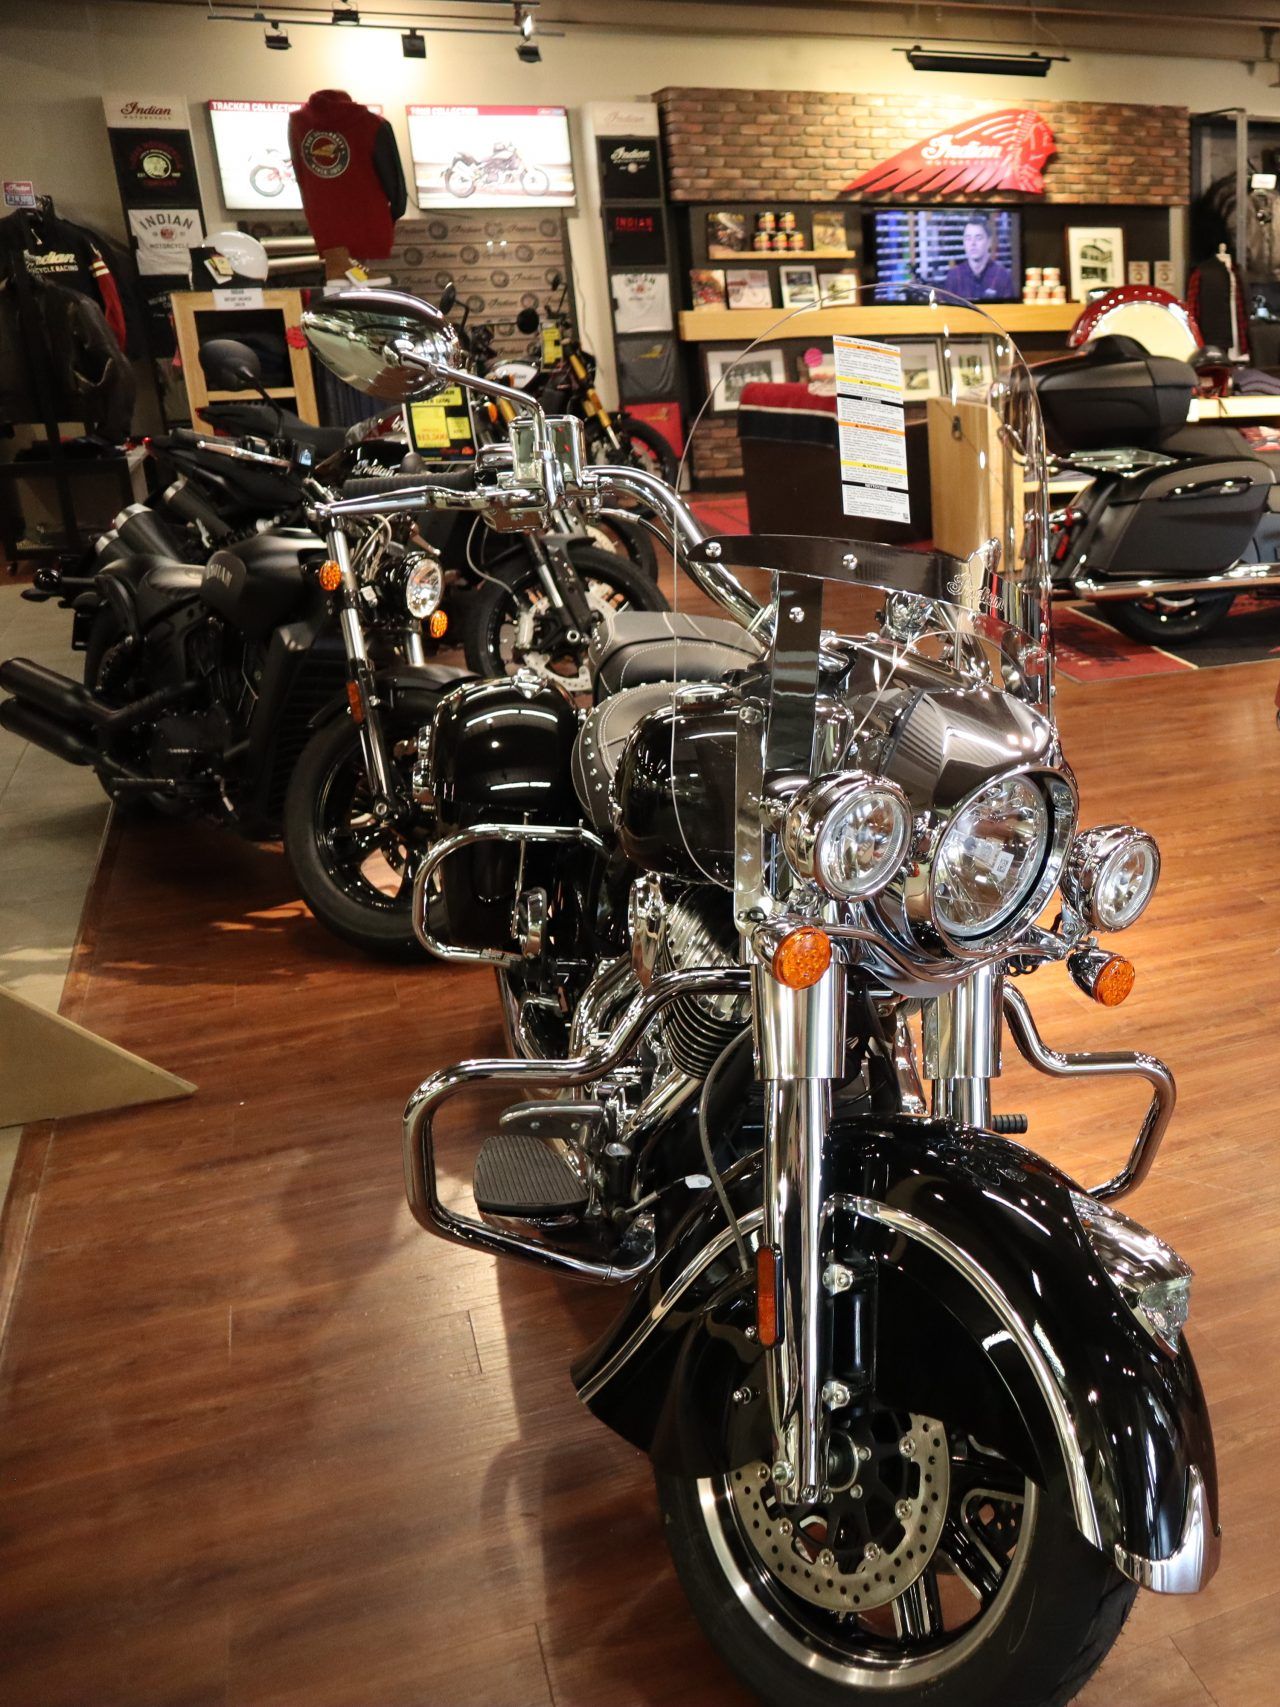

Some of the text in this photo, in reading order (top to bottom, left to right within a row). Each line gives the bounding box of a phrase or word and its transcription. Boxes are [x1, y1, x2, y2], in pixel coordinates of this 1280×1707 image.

[120, 102, 172, 116] Indian
[211, 101, 250, 111] TRACKER
[610, 146, 651, 161] Indian
[921, 135, 1003, 158] Indian
[138, 213, 193, 231] INDIAN
[615, 216, 653, 228] INDIAN
[55, 264, 79, 273] RACING
[352, 459, 396, 478] Indian
[946, 572, 1004, 611] Indian
